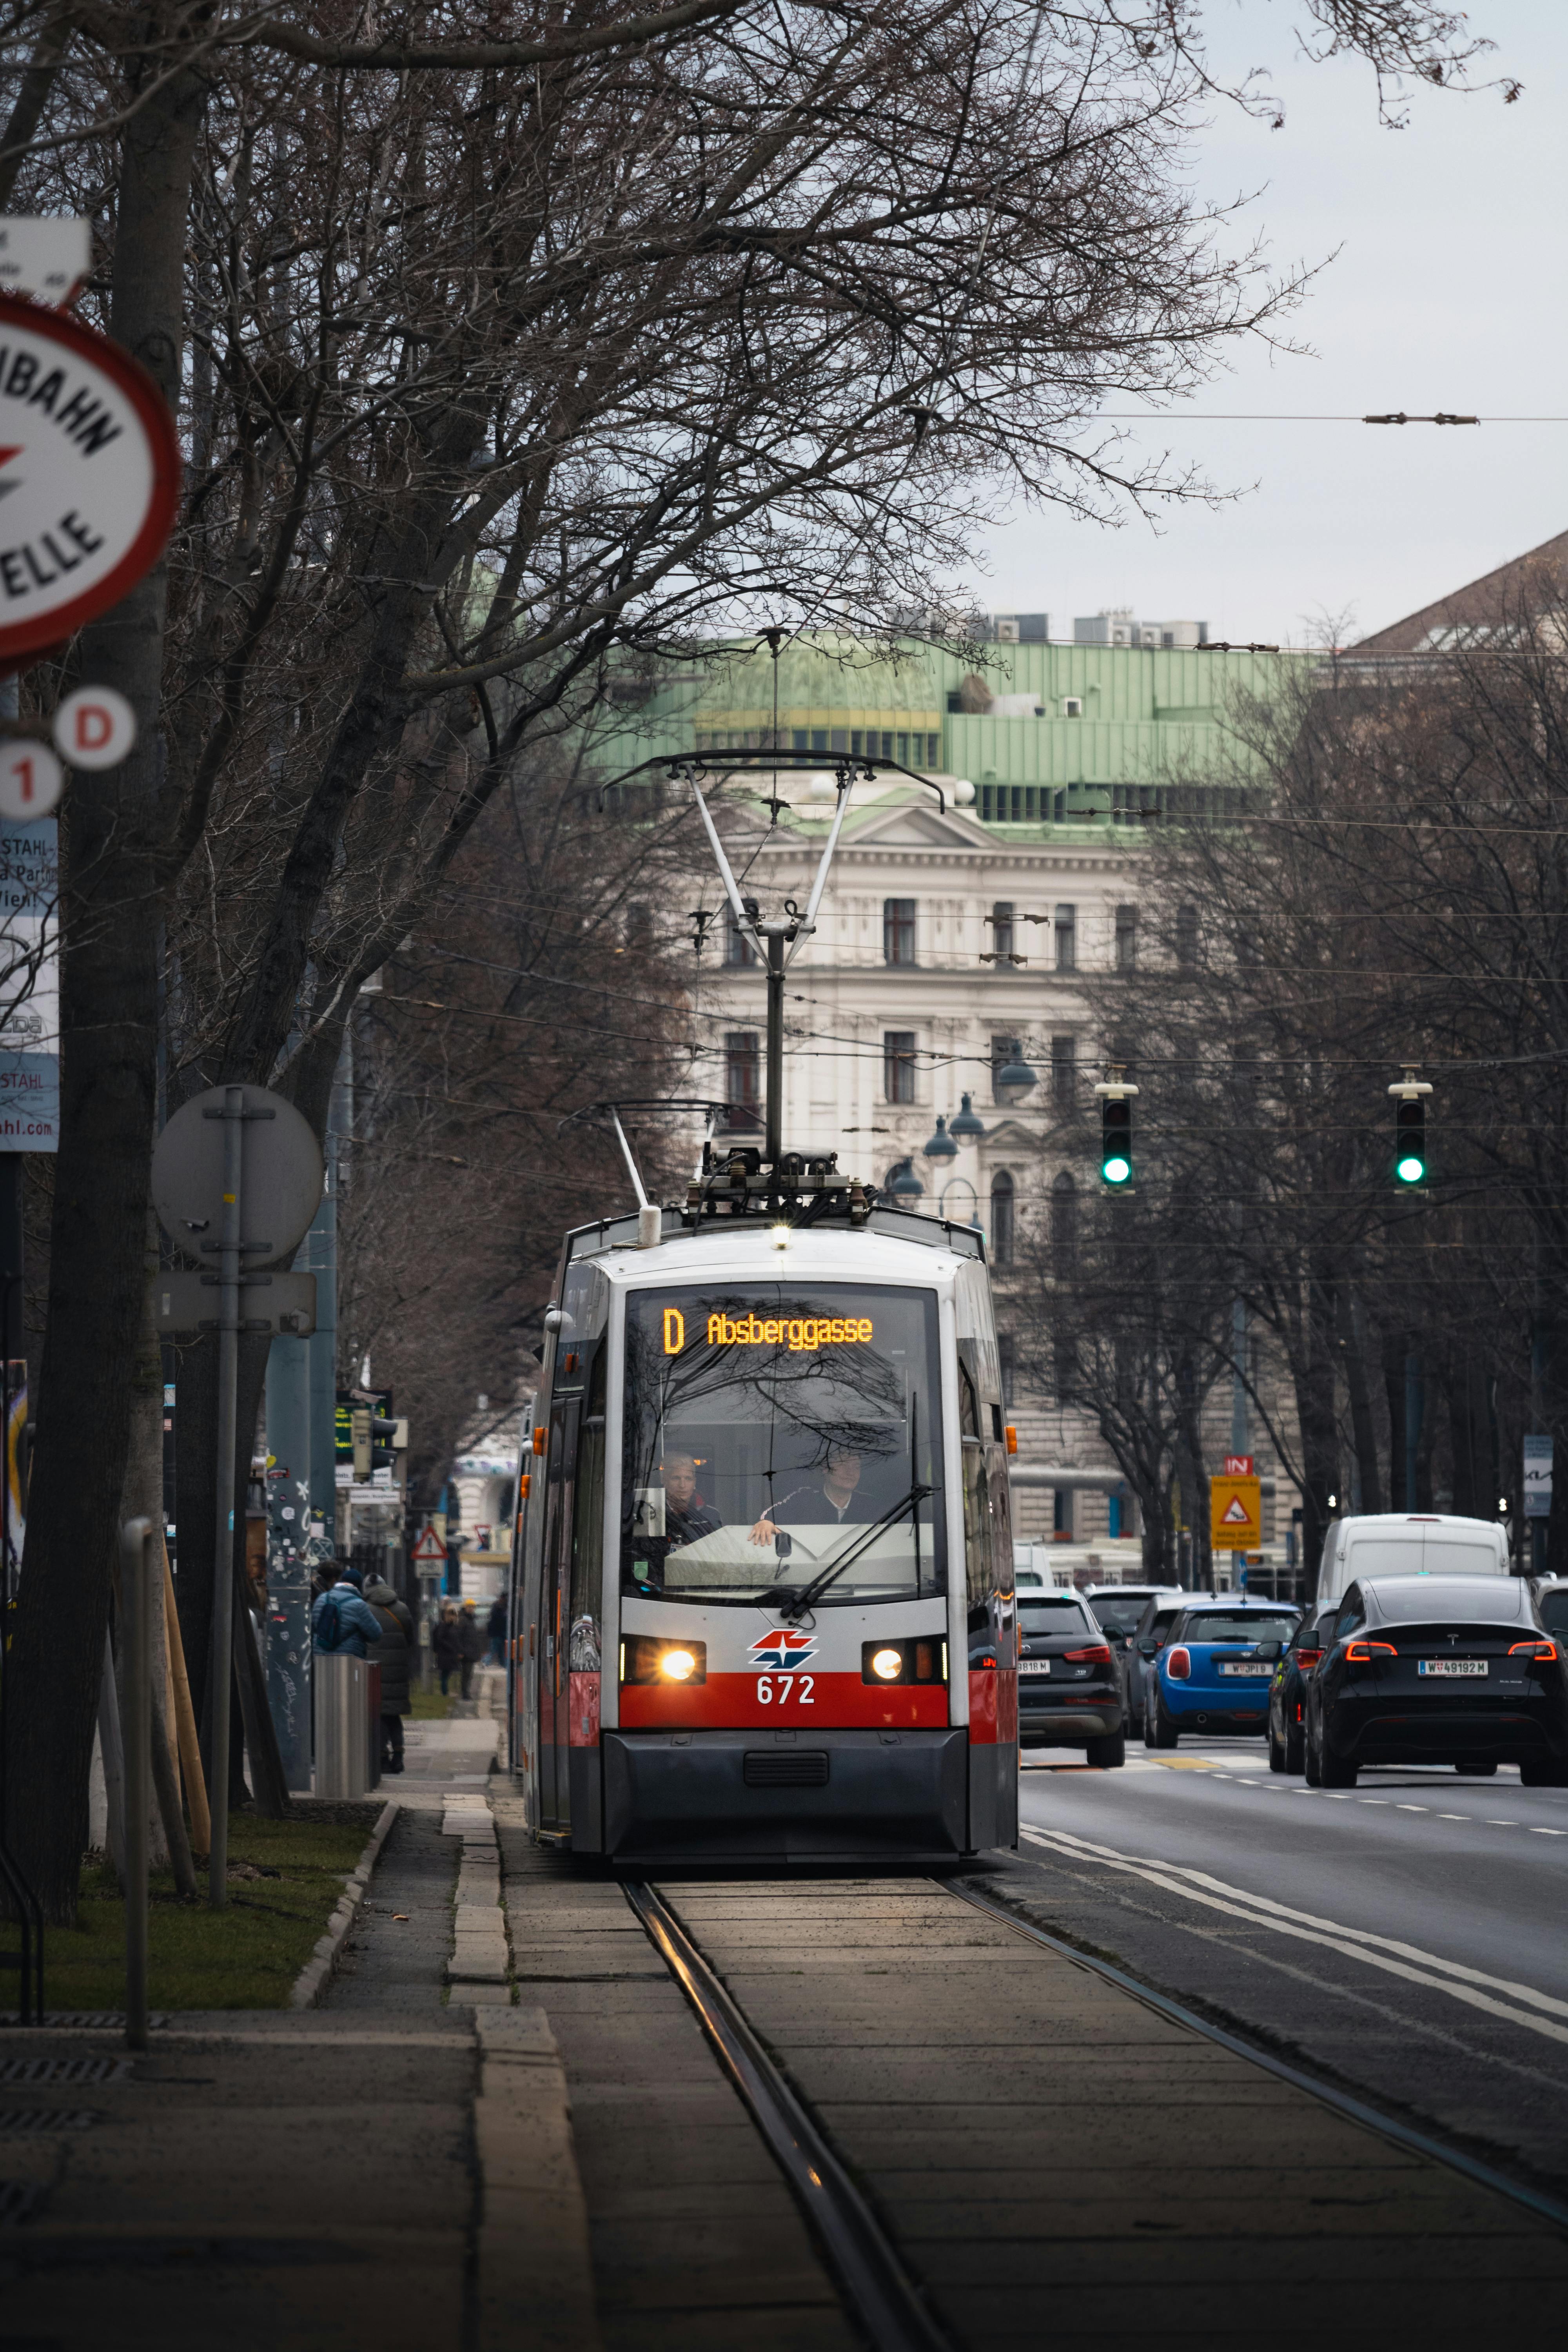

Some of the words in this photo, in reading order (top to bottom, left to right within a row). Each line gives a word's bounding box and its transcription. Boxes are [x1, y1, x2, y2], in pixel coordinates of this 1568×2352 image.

[74, 704, 113, 751] D
[12, 757, 34, 803] 1
[0, 890, 36, 907] ien!
[1, 1073, 43, 1089] STAHL
[664, 1308, 684, 1354] D
[707, 1312, 873, 1350] Absberggasse
[1040, 1661, 1046, 1671] M
[1233, 1664, 1240, 1673] W
[1428, 1662, 1436, 1673] W
[1444, 1662, 1475, 1673] 49192
[1478, 1662, 1485, 1673] M
[757, 1675, 815, 1704] 672
